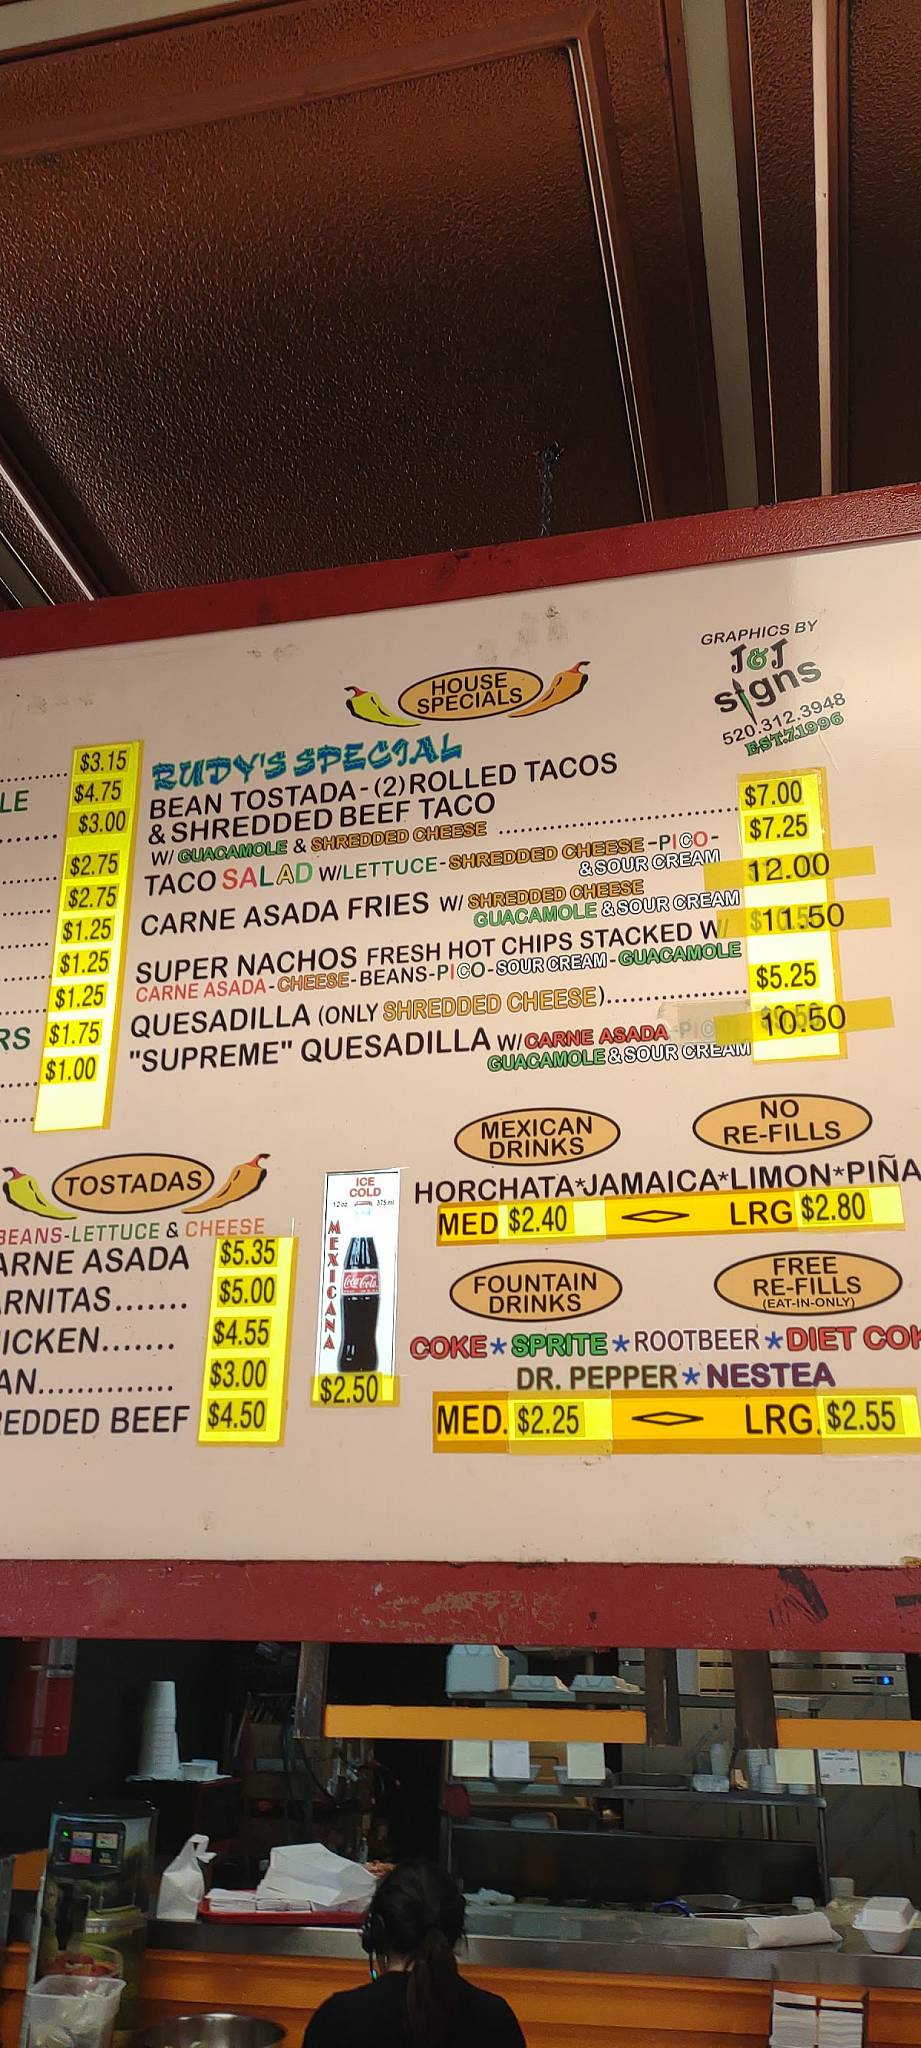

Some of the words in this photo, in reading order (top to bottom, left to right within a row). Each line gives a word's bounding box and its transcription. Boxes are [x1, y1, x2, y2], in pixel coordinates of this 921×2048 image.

[701, 624, 790, 645] GRAPHICS
[795, 619, 818, 634] BY
[730, 638, 789, 674] J&J
[432, 672, 508, 696] HOUSE
[417, 687, 523, 714] SPECIALS
[722, 693, 846, 745] 520.312.3948
[79, 750, 128, 772] $3.15
[152, 750, 287, 791] RUDY'S
[293, 733, 463, 777] SPECIAL
[73, 781, 122, 804] $4.75
[150, 793, 222, 819] BEAN
[231, 780, 356, 812] TOSTADA
[524, 752, 618, 782] TACOS
[744, 780, 802, 808] $7.00
[78, 811, 126, 834] $3.00
[340, 799, 411, 828] BEEF
[418, 792, 496, 820] TACO
[749, 815, 808, 841] $7.25
[151, 850, 174, 866] W/
[177, 840, 288, 865] GUACAMOLE
[293, 838, 307, 854] &
[310, 828, 409, 852] SHREDDED
[413, 821, 488, 843] CHEESE
[70, 853, 119, 877] $2.75
[145, 870, 216, 897] TACO
[222, 862, 313, 890] SALAD
[449, 845, 558, 871] SHREDDED
[561, 837, 645, 858] CHEESE
[659, 831, 709, 851] PICO
[651, 849, 720, 870] CREAM
[748, 853, 830, 883] 12.00
[68, 886, 117, 909] $2.75
[140, 908, 236, 937] CARNE
[243, 899, 339, 929] ASADA
[348, 892, 429, 920] FRIES
[439, 895, 464, 913] W/
[467, 887, 566, 910] SHREDDED
[570, 879, 645, 899] CHEESE
[473, 902, 598, 928] GUACAMOLE
[672, 890, 740, 910] CREAM
[62, 918, 112, 942] $1.25
[762, 903, 845, 932] 11.50
[60, 950, 109, 975] $1.25
[135, 956, 228, 985] SUPER
[237, 946, 358, 980] NACHOS
[367, 943, 441, 966] FRESH
[448, 938, 496, 960] HOT
[501, 932, 573, 955] CHIPS
[580, 922, 692, 949] STACKED
[135, 981, 199, 1003] CARNE
[203, 977, 267, 999] ASADA
[276, 971, 350, 993] CHEESE
[360, 966, 428, 987] BEANS
[436, 962, 486, 981] PICO
[496, 957, 544, 977] SOUR
[547, 952, 608, 972] CREAM
[617, 941, 742, 967] GUACAMOLE
[755, 962, 817, 991] $5.25
[55, 984, 104, 1009] $1.25
[130, 1003, 311, 1039] QUESADILLA
[318, 1002, 379, 1026] (ONLY
[382, 993, 502, 1022] SHREDDED
[506, 985, 605, 1013] CHEESE)
[762, 1004, 846, 1037] 10.50
[49, 1021, 100, 1046] $1.75
[301, 1027, 491, 1062] QUESADILLA
[598, 1024, 669, 1045] ASADA
[45, 1057, 96, 1083] $1.00
[487, 1049, 606, 1072] GUACAMOLE
[760, 1099, 800, 1120] NO
[481, 1115, 592, 1139] MEXICAN
[723, 1120, 842, 1145] RE-FILLS
[489, 1137, 585, 1160] DRINKS
[64, 1170, 202, 1198] TOSTADAS
[349, 1187, 382, 1198] COLD
[356, 1176, 376, 1187] ICE
[439, 1212, 498, 1236] MED
[508, 1204, 567, 1235] $2.40
[730, 1200, 793, 1226] LRG
[801, 1192, 866, 1222] $2.80
[0, 1226, 62, 1245] BEANS
[71, 1222, 161, 1243] LETTUCE
[166, 1222, 180, 1238] &
[185, 1217, 265, 1237] CHEESE
[82, 1244, 191, 1274] ASADA
[220, 1238, 276, 1267] $5.35
[773, 1256, 839, 1276] FREE
[219, 1277, 276, 1305] $5.00
[323, 1219, 341, 1350] MEXICANA
[473, 1272, 598, 1295] FOUNTAIN
[753, 1276, 862, 1297] RE-FILLS
[0, 1286, 111, 1315] RNITAS
[489, 1293, 582, 1314] DRINKS
[762, 1297, 856, 1312] (EAT-IN-ONLY)
[0, 1326, 100, 1356] ICKEN
[212, 1318, 270, 1347] $4.55
[410, 1335, 488, 1360] COKE
[511, 1332, 609, 1358] SPRITE
[634, 1328, 760, 1352] ROOTBEER
[786, 1325, 857, 1352] DIET
[210, 1359, 267, 1389] $3.00
[517, 1367, 561, 1391] DR.
[570, 1364, 678, 1390] PEPPER
[706, 1361, 837, 1389] NESTEA
[320, 1374, 379, 1406] $2.50
[110, 1405, 191, 1434] BEEF
[207, 1400, 266, 1430] $4.50
[437, 1405, 508, 1435] MED.
[518, 1404, 579, 1435] $2.25
[745, 1404, 822, 1436] LRG.
[827, 1400, 896, 1432] $2.55
